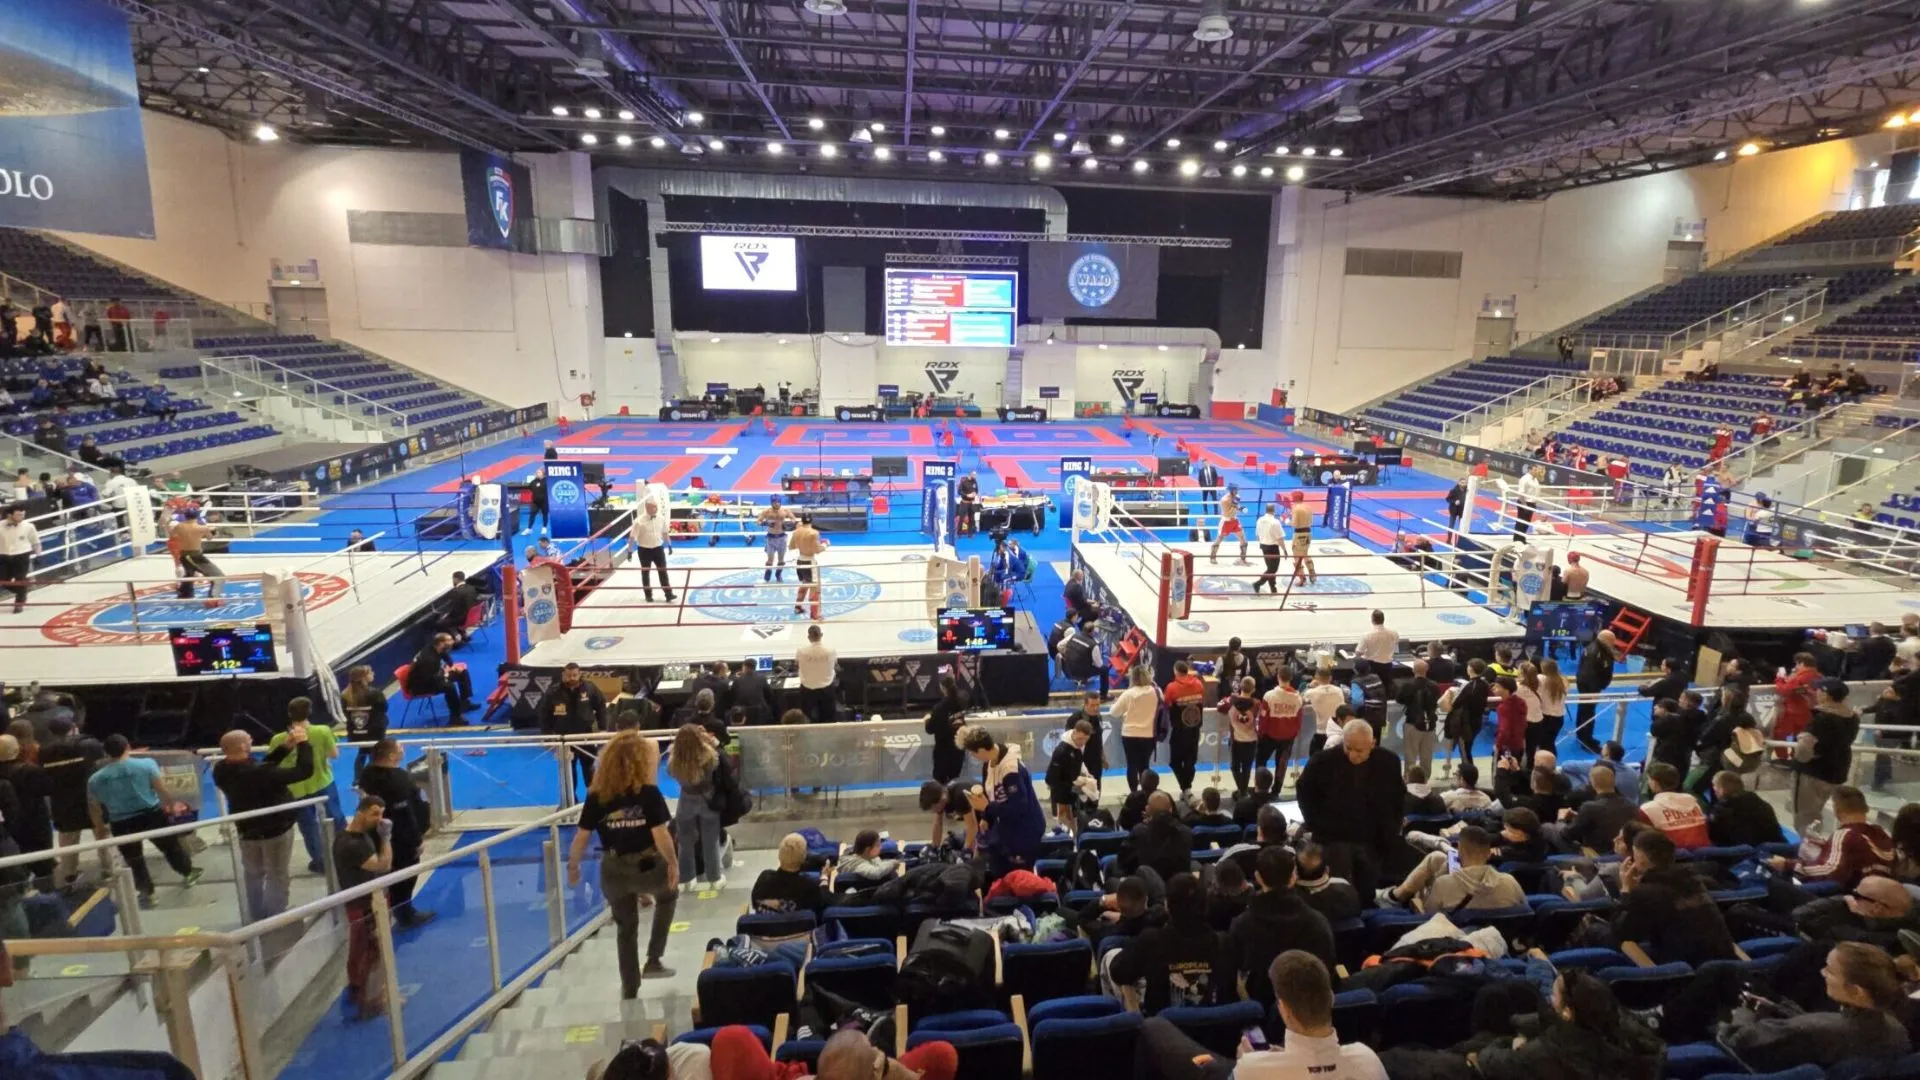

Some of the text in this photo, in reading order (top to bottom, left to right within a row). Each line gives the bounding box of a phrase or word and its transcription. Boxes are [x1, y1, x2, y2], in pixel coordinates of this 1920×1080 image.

[925, 361, 961, 369] RDX
[925, 466, 953, 476] RING 2
[1063, 461, 1082, 471] RING
[548, 466, 577, 477] RING 1
[868, 656, 902, 664] RDX
